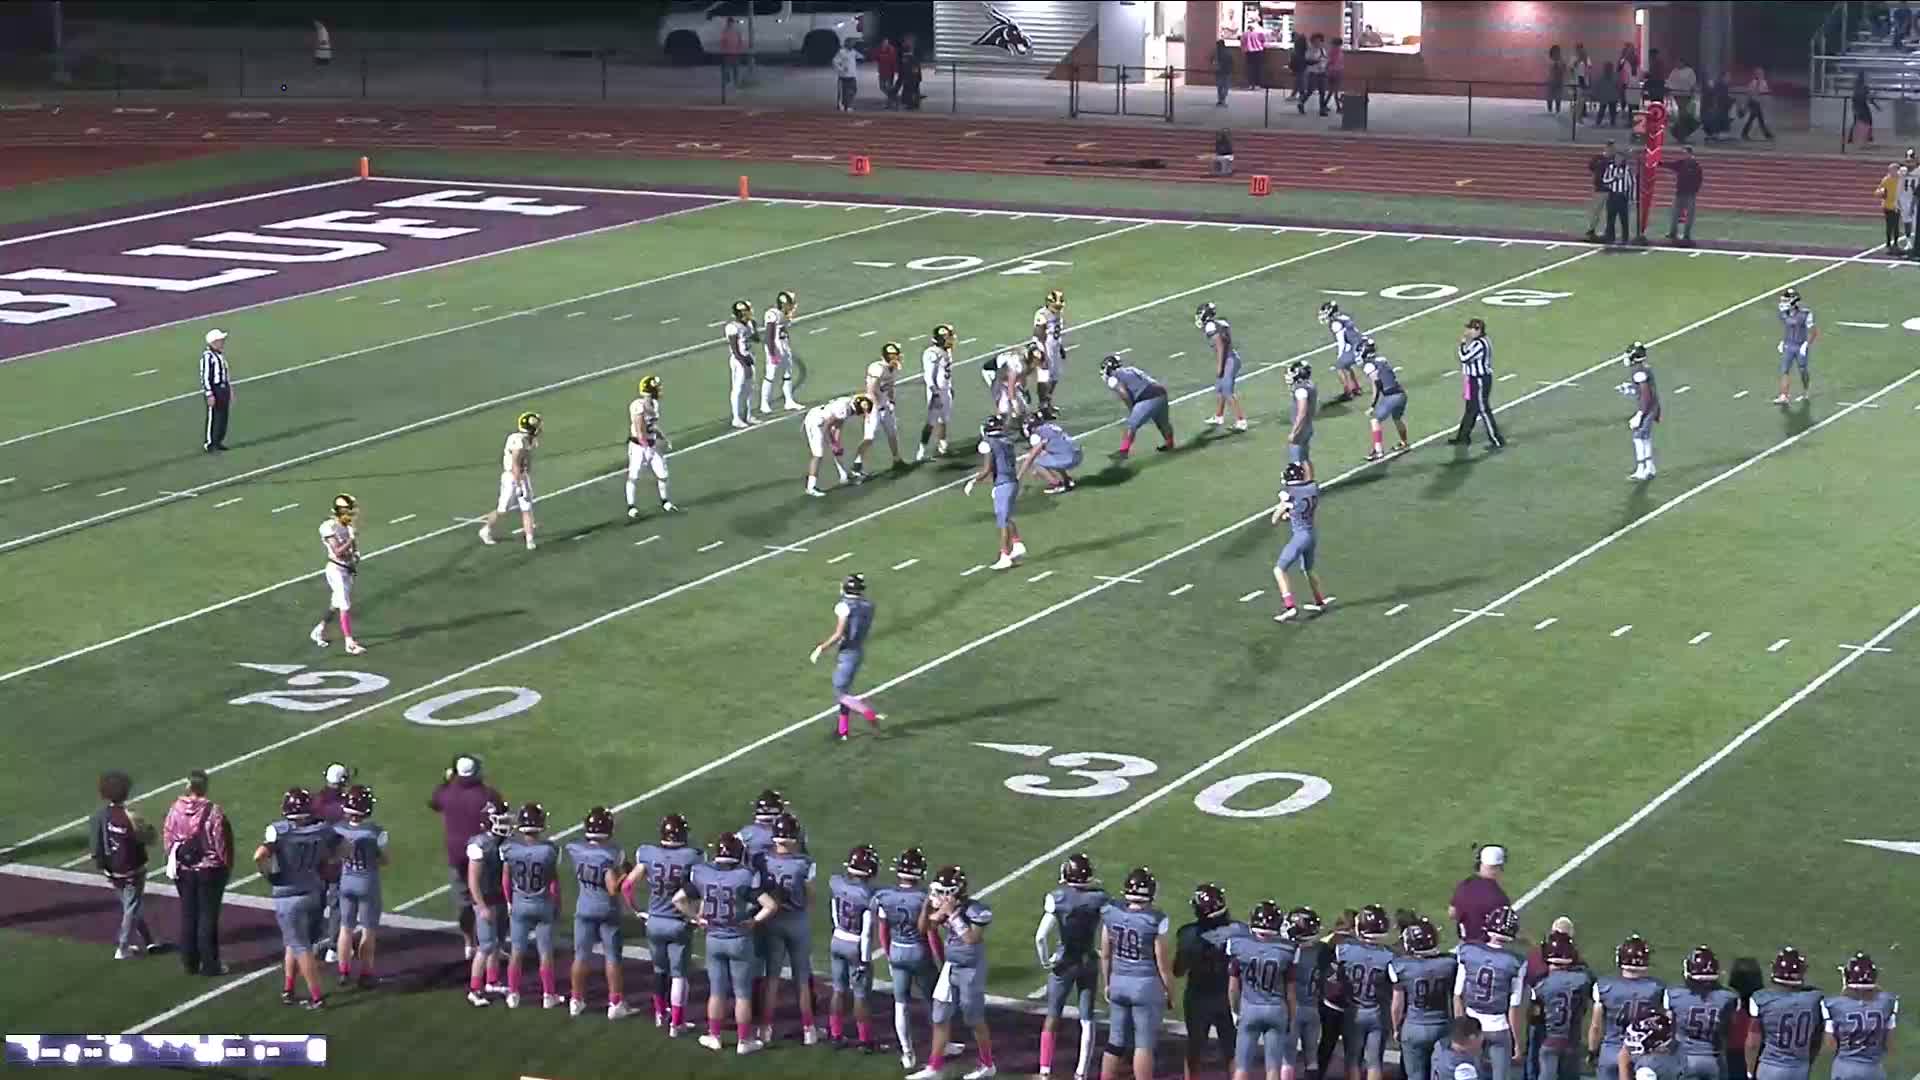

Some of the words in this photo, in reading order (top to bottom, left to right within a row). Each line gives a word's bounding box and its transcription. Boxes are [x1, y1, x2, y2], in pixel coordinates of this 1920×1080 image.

[1253, 176, 1266, 193] 10
[1245, 956, 1280, 992] 40
[1476, 966, 1496, 1003] 9
[1778, 1009, 1812, 1049] 60
